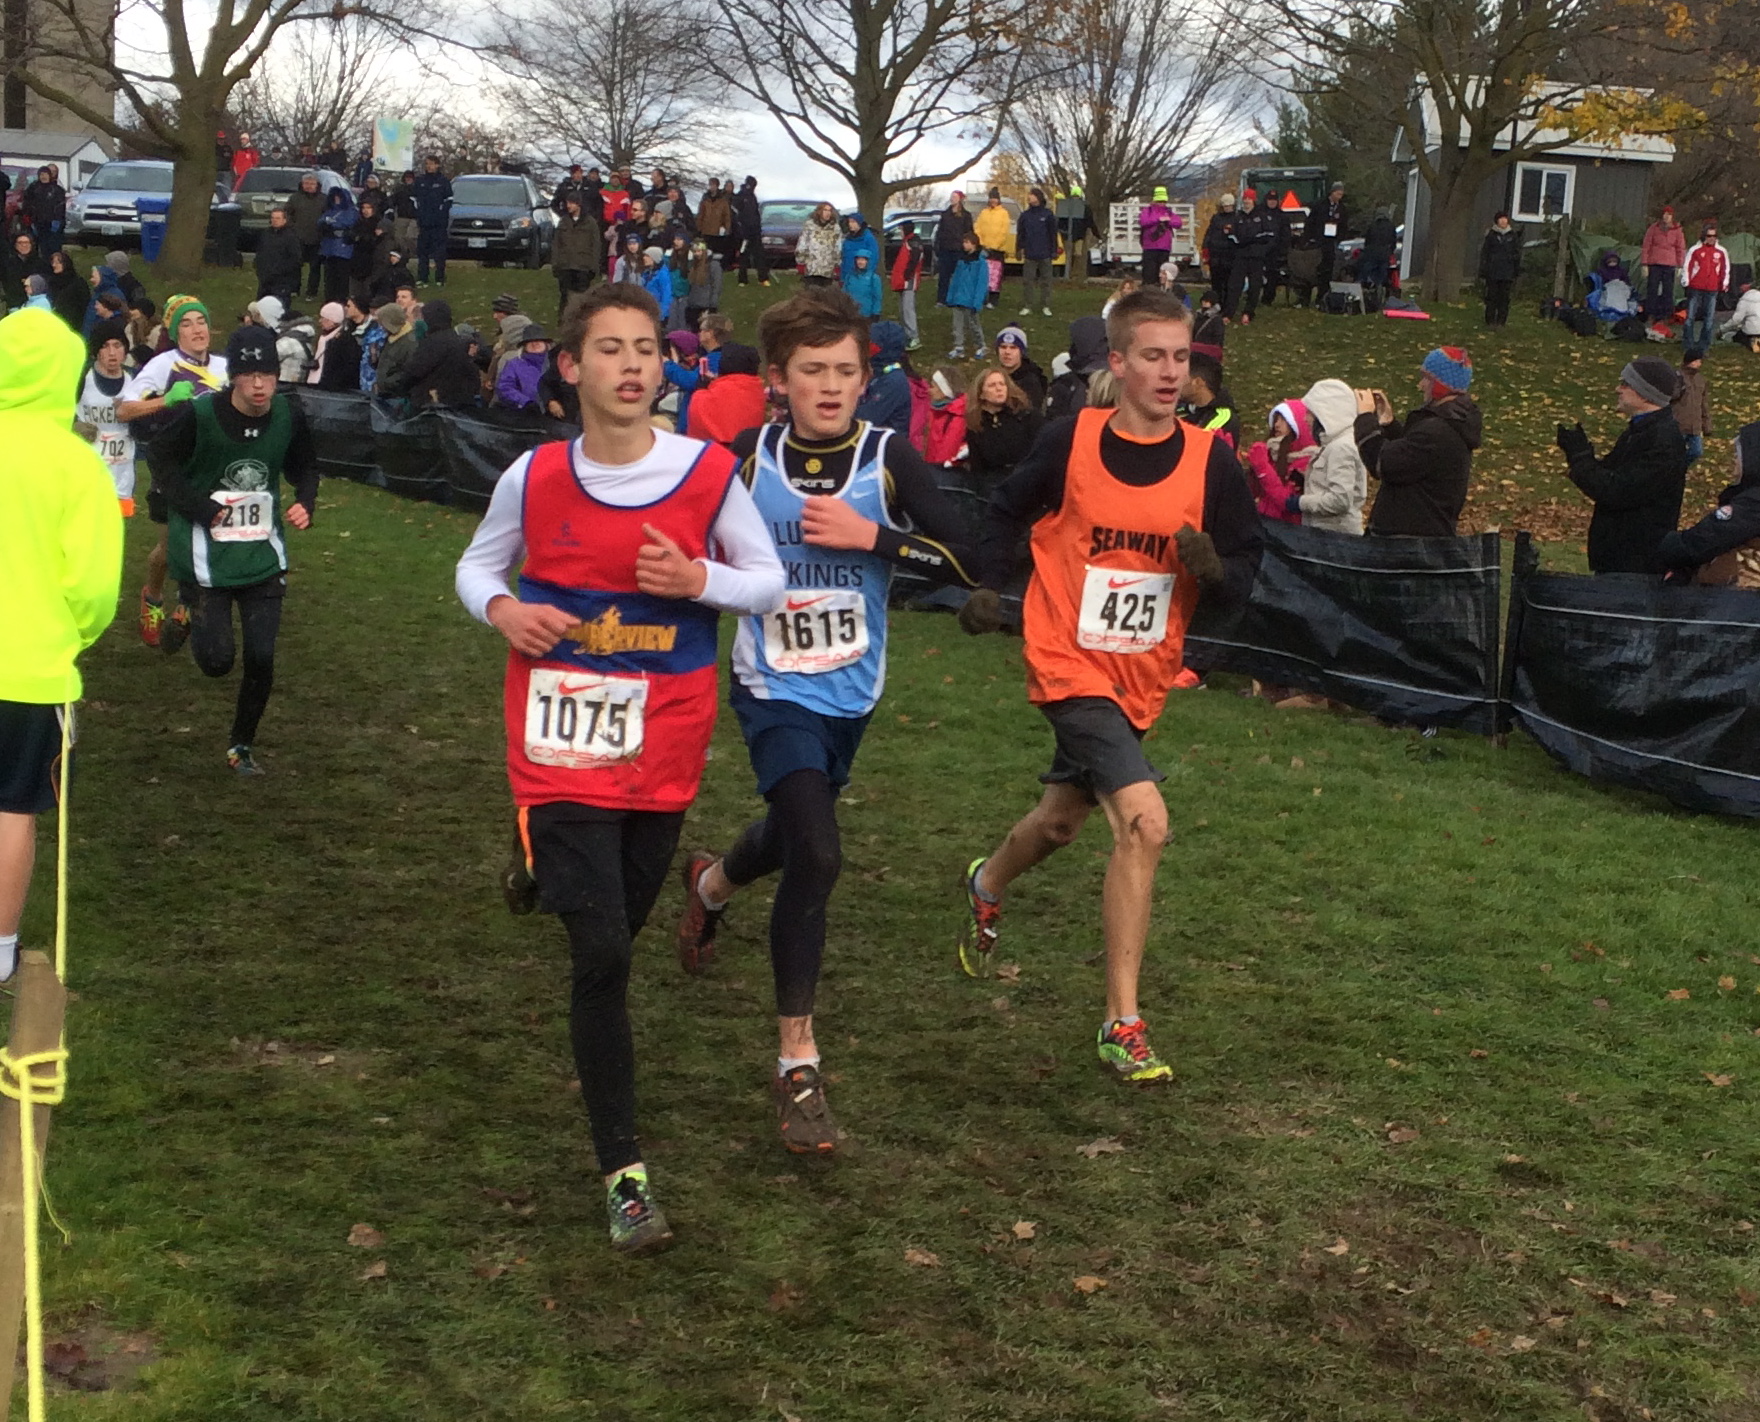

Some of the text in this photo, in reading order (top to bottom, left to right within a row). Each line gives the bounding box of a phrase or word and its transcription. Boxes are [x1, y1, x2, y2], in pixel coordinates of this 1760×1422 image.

[101, 439, 125, 457] 702
[221, 503, 261, 528] 218
[773, 520, 802, 546] LU
[1089, 525, 1171, 565] SEAWAY
[782, 560, 864, 588] KINGS
[1100, 591, 1158, 633] 425
[774, 608, 857, 652] 1615
[539, 694, 631, 748] 1075
